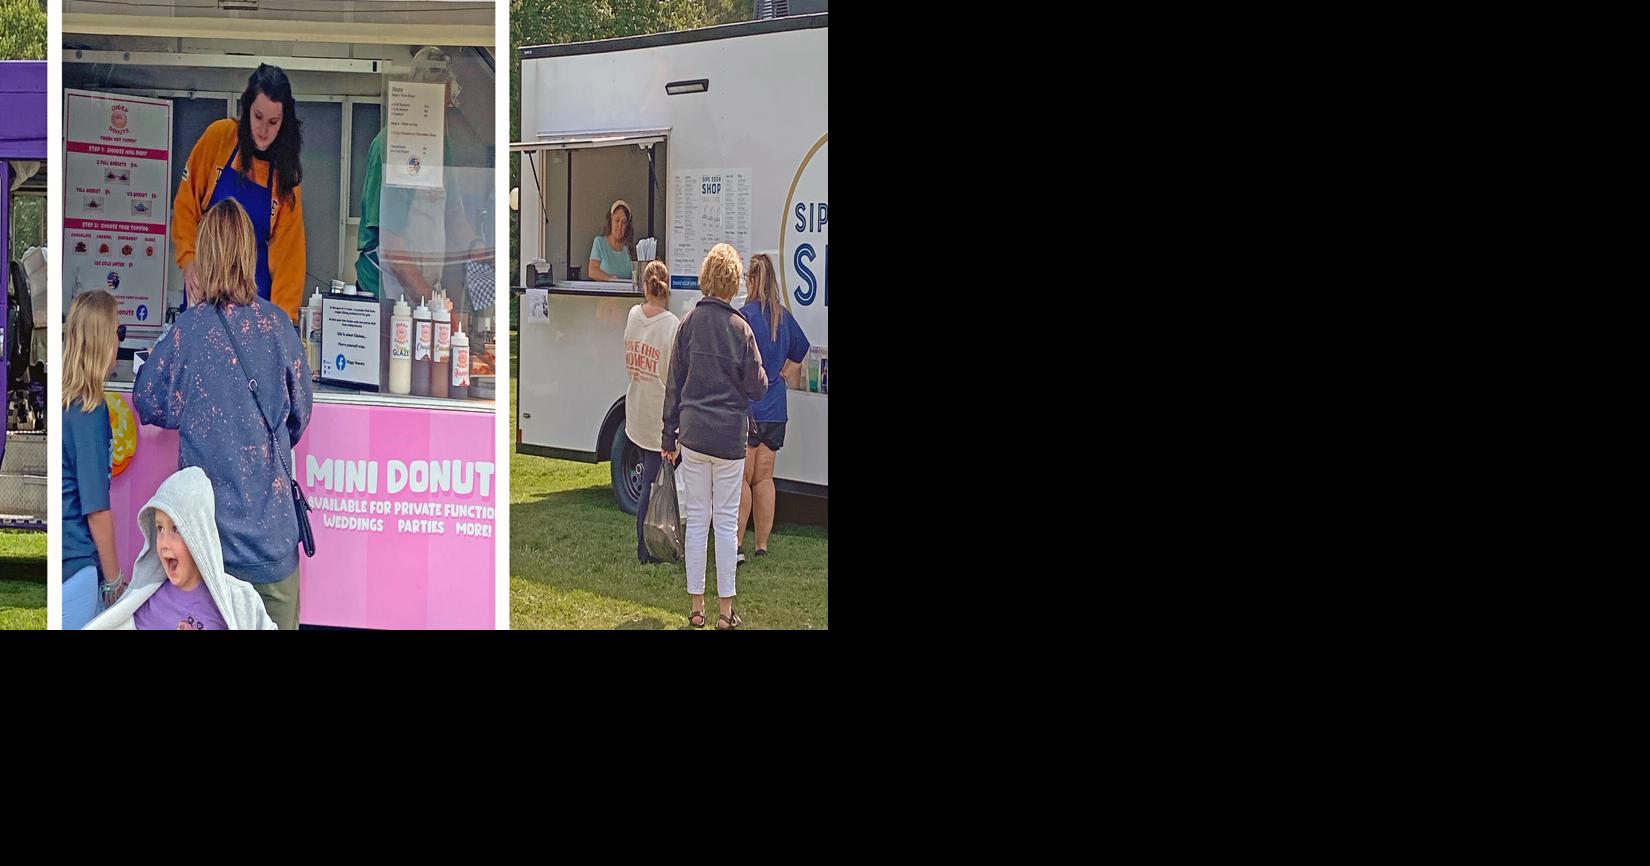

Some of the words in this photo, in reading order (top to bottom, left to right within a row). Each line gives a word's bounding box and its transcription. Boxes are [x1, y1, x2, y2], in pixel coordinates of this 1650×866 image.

[702, 183, 721, 195] SHOP
[795, 202, 828, 232] SIP
[794, 243, 828, 306] S
[393, 349, 409, 357] GLAZE
[641, 342, 660, 360] THIS
[305, 454, 378, 494] MINI
[387, 459, 495, 497] DONUT
[307, 495, 367, 514] AVAILABLE
[369, 501, 391, 515] FOR
[394, 501, 442, 517] PRIVATE
[444, 503, 495, 520] FUNCTIO
[323, 513, 384, 532] WEDDINGS
[398, 519, 445, 534] PARTIES
[455, 522, 492, 538] MORE!
